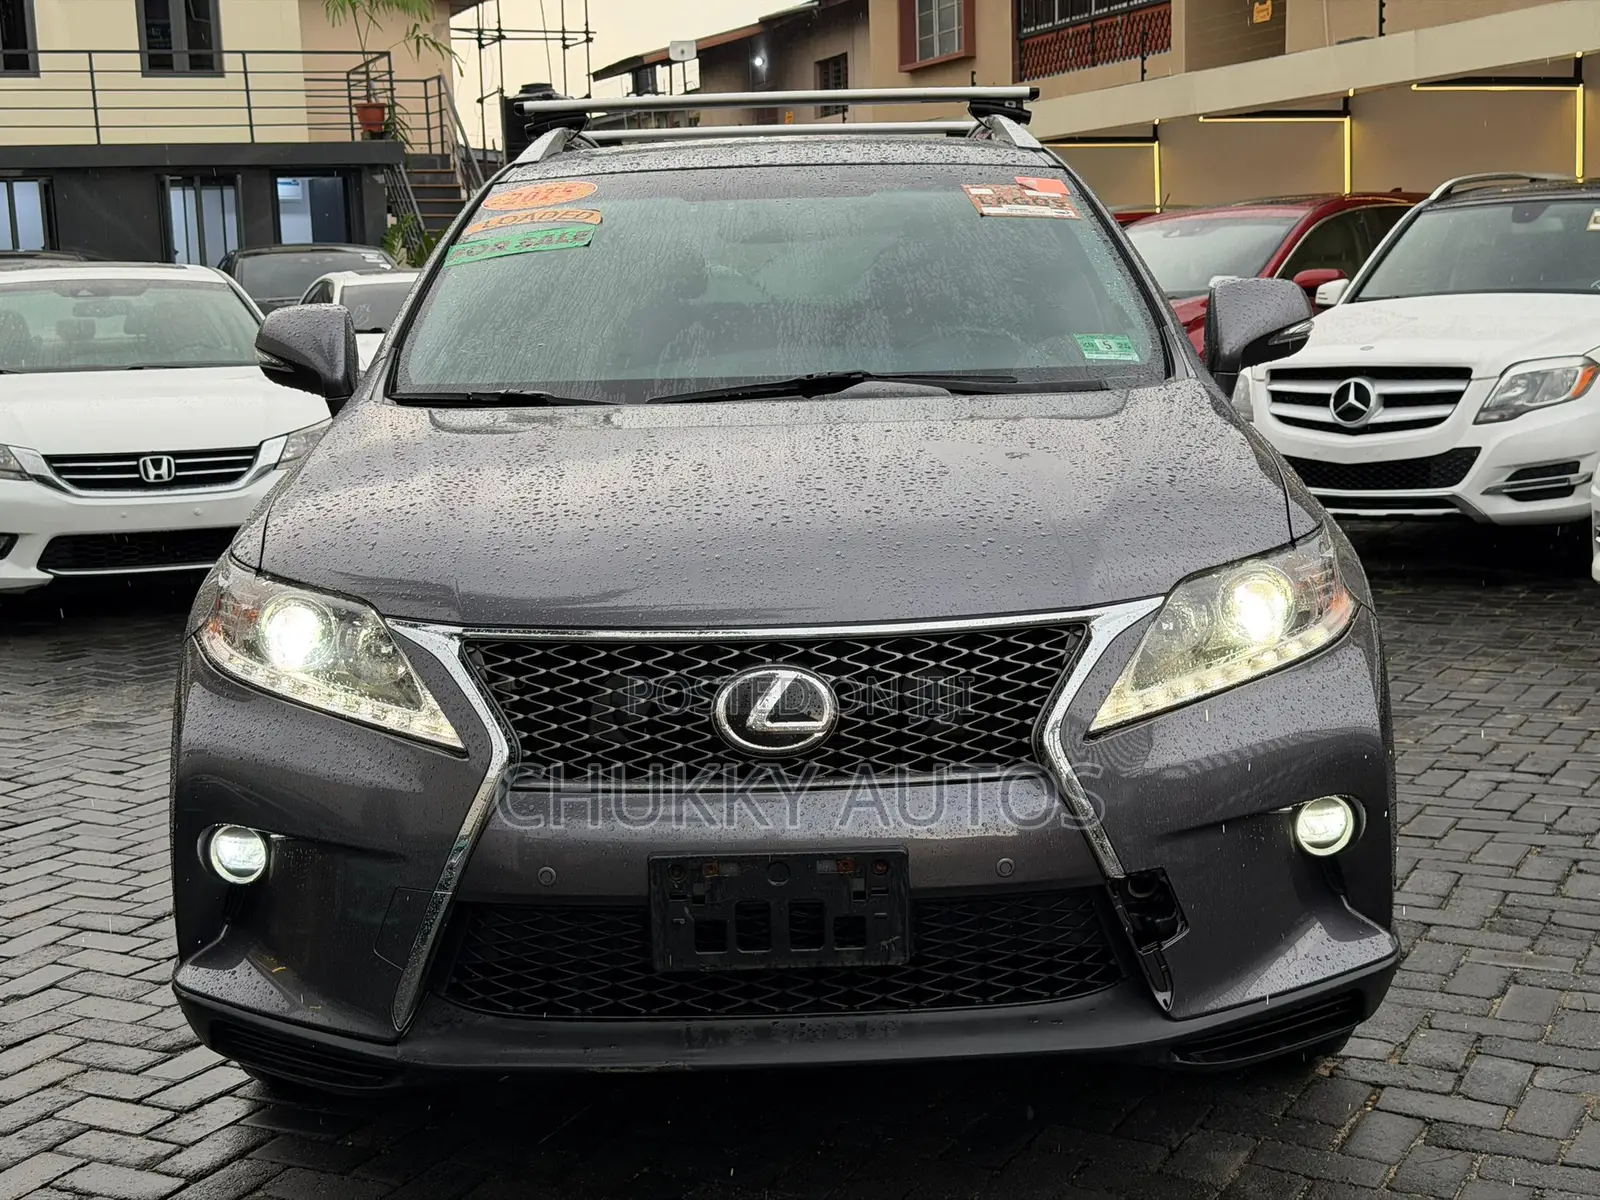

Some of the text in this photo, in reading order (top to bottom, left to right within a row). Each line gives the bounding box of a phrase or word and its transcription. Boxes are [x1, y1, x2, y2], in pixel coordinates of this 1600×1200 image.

[482, 210, 595, 229] LOADED
[450, 231, 589, 260] FOR SALE
[1102, 340, 1113, 350] 5
